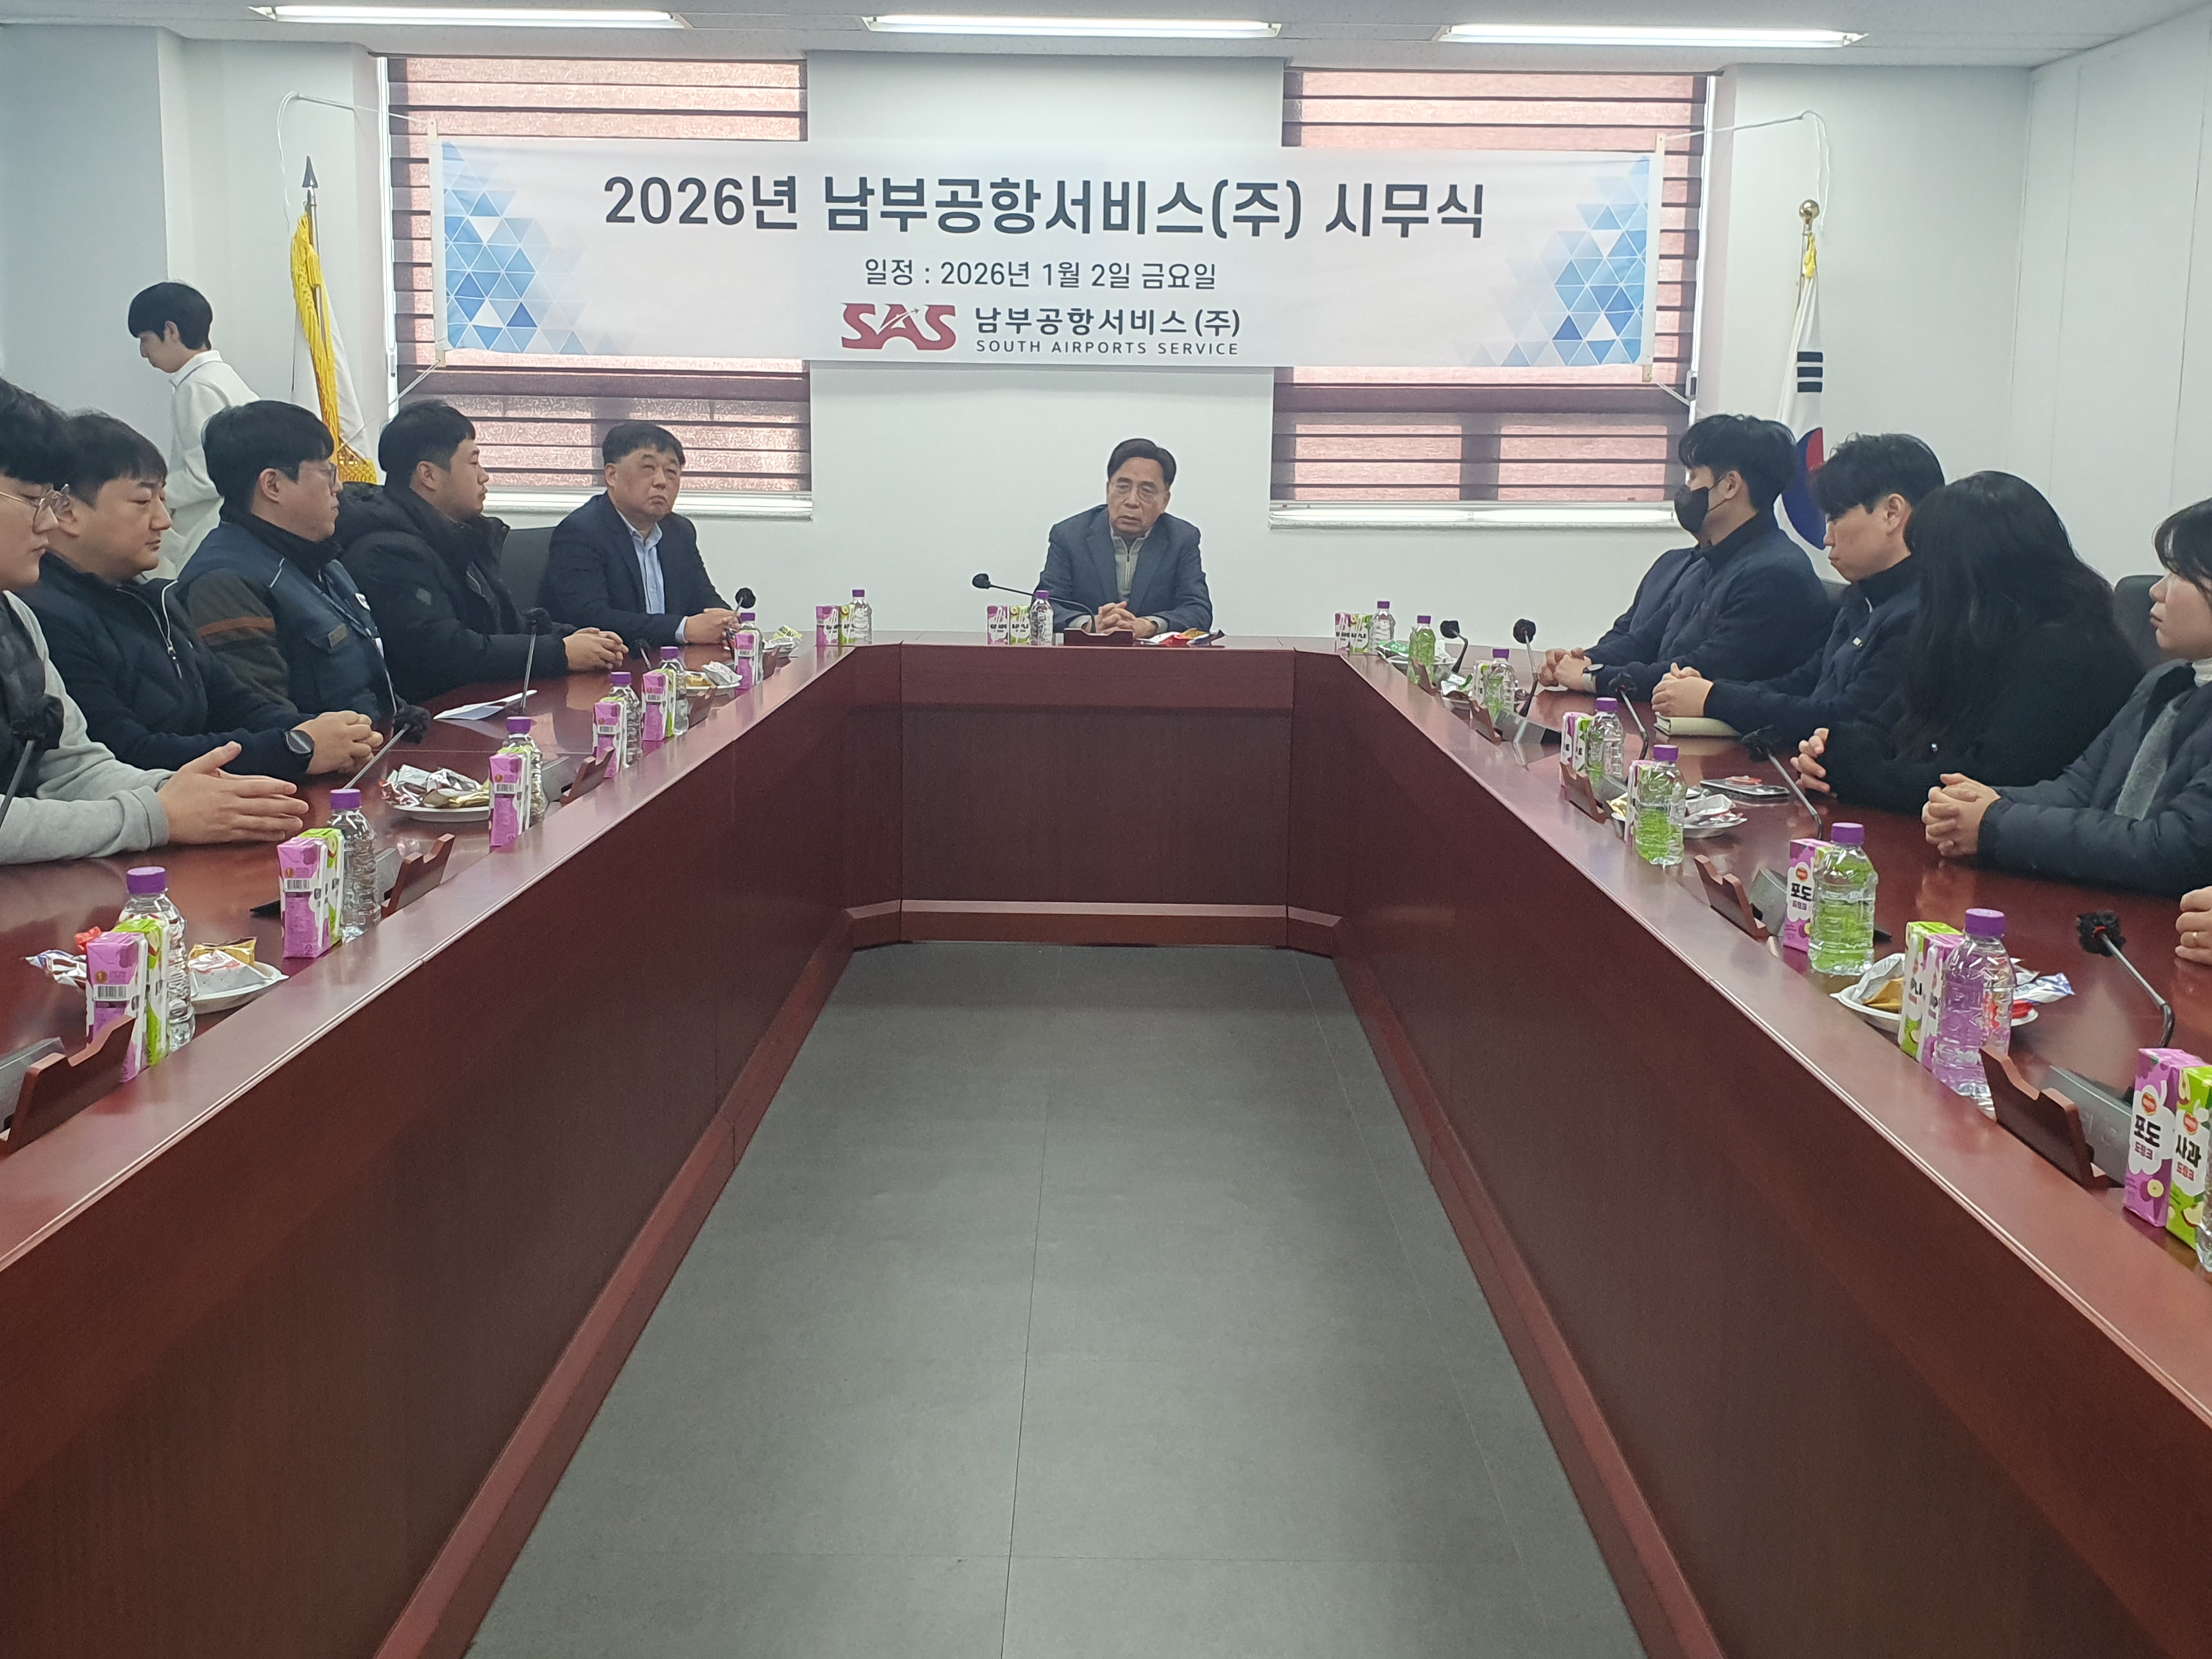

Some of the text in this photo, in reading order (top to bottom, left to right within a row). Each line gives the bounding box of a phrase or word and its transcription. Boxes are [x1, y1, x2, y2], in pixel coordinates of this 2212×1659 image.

[605, 176, 1483, 239] 2026년 남부공항서비스(주) 시무식
[865, 259, 913, 285] 일정
[941, 261, 1029, 287] 2026년
[1042, 262, 1079, 288] 1월
[1091, 262, 1130, 289] 2일
[1142, 263, 1215, 290] 금요일
[841, 303, 956, 351] SAS
[977, 340, 1238, 356] SOUTH AIRPORTS SERVICE
[1791, 882, 1812, 902] 포도
[2134, 1114, 2161, 1148] 포도
[2175, 1134, 2202, 1169] 사과
